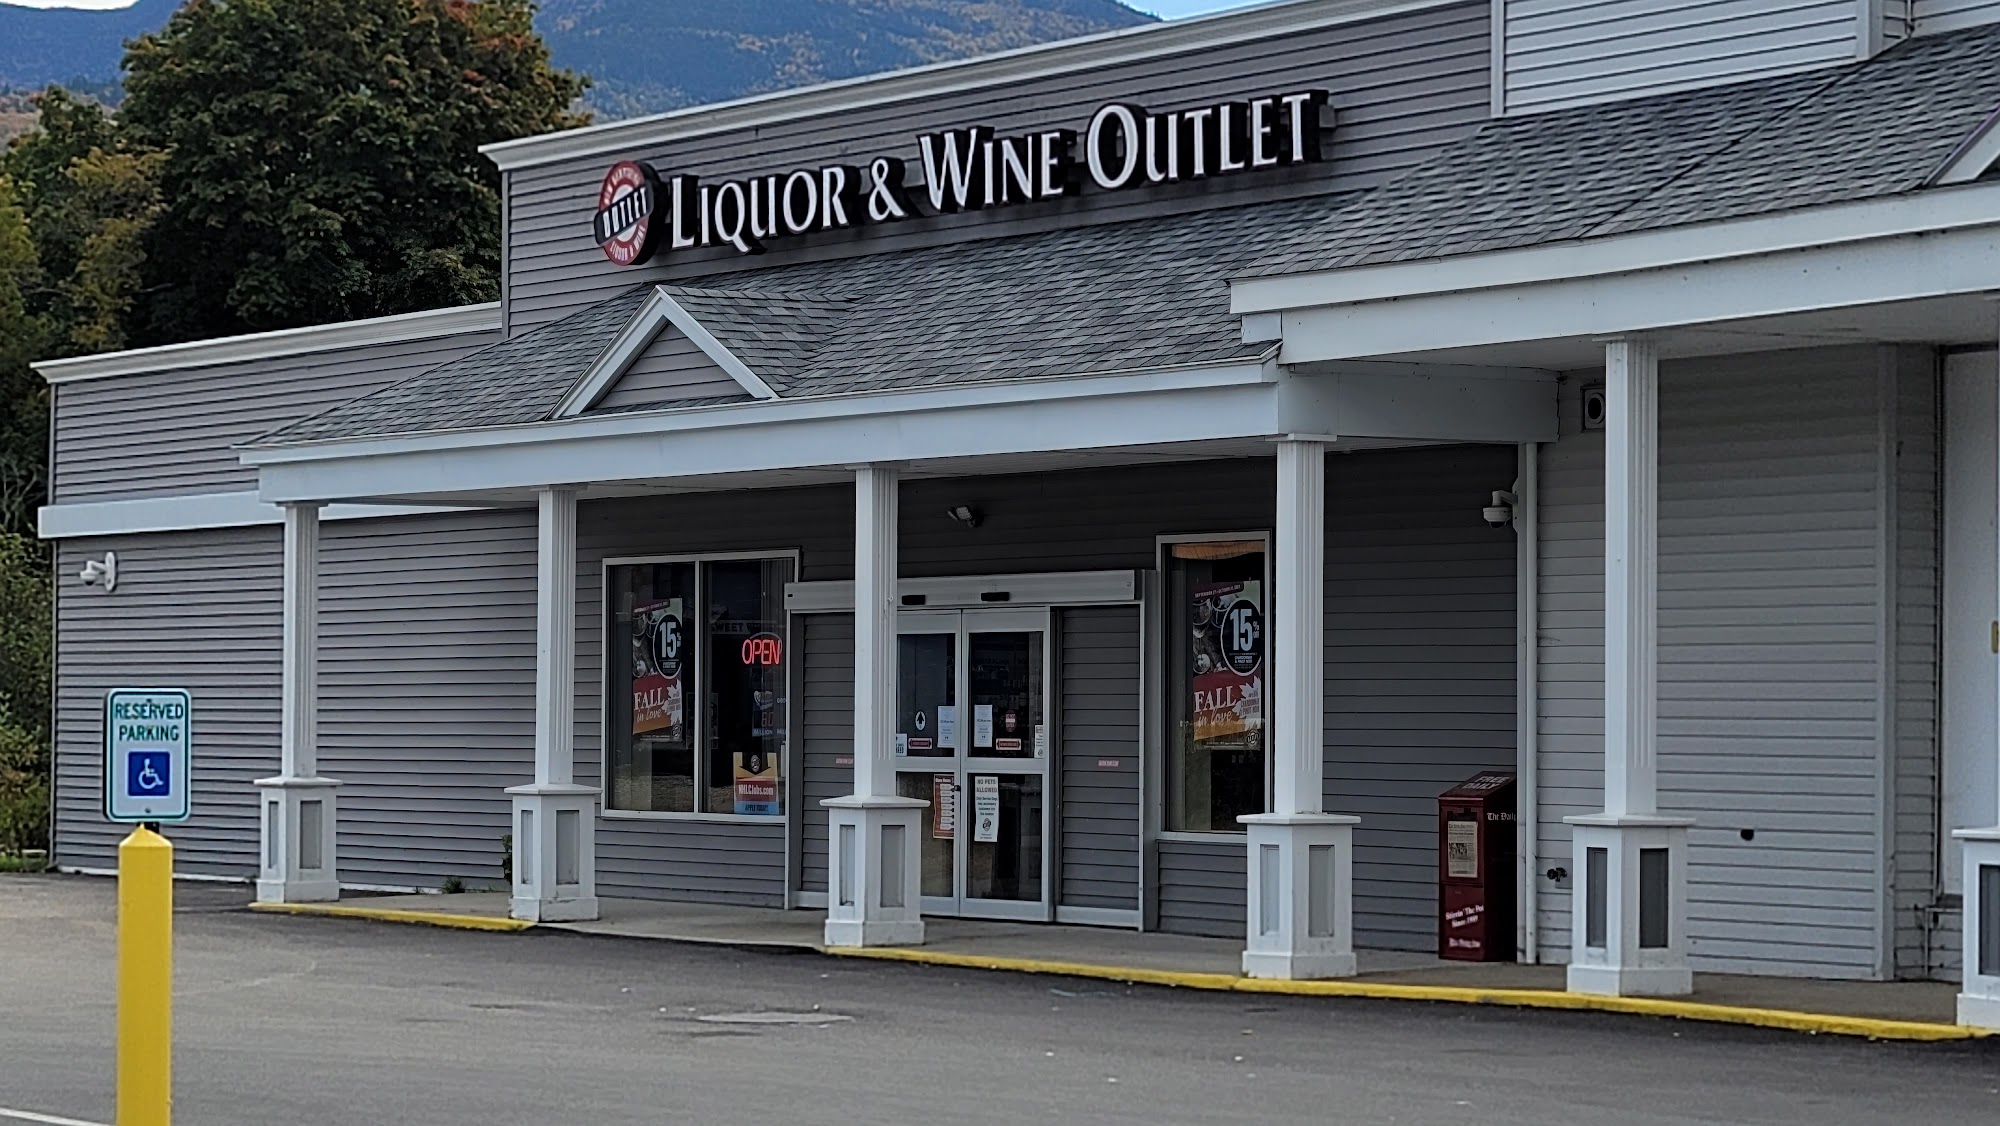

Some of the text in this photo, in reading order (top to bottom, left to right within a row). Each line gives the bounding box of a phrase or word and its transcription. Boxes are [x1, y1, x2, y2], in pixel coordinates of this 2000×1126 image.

[672, 92, 1311, 253] LIQUOR & WINE OUTLET
[602, 187, 647, 238] OUTLET
[660, 621, 677, 658] 15
[1230, 608, 1253, 652] 15
[742, 639, 781, 665] OPEN
[114, 703, 184, 719] RESERVED
[634, 687, 665, 711] FALL
[1194, 685, 1237, 713] FALL
[119, 725, 179, 741] PARKING
[1486, 812, 1499, 821] The
[1465, 906, 1475, 915] The
